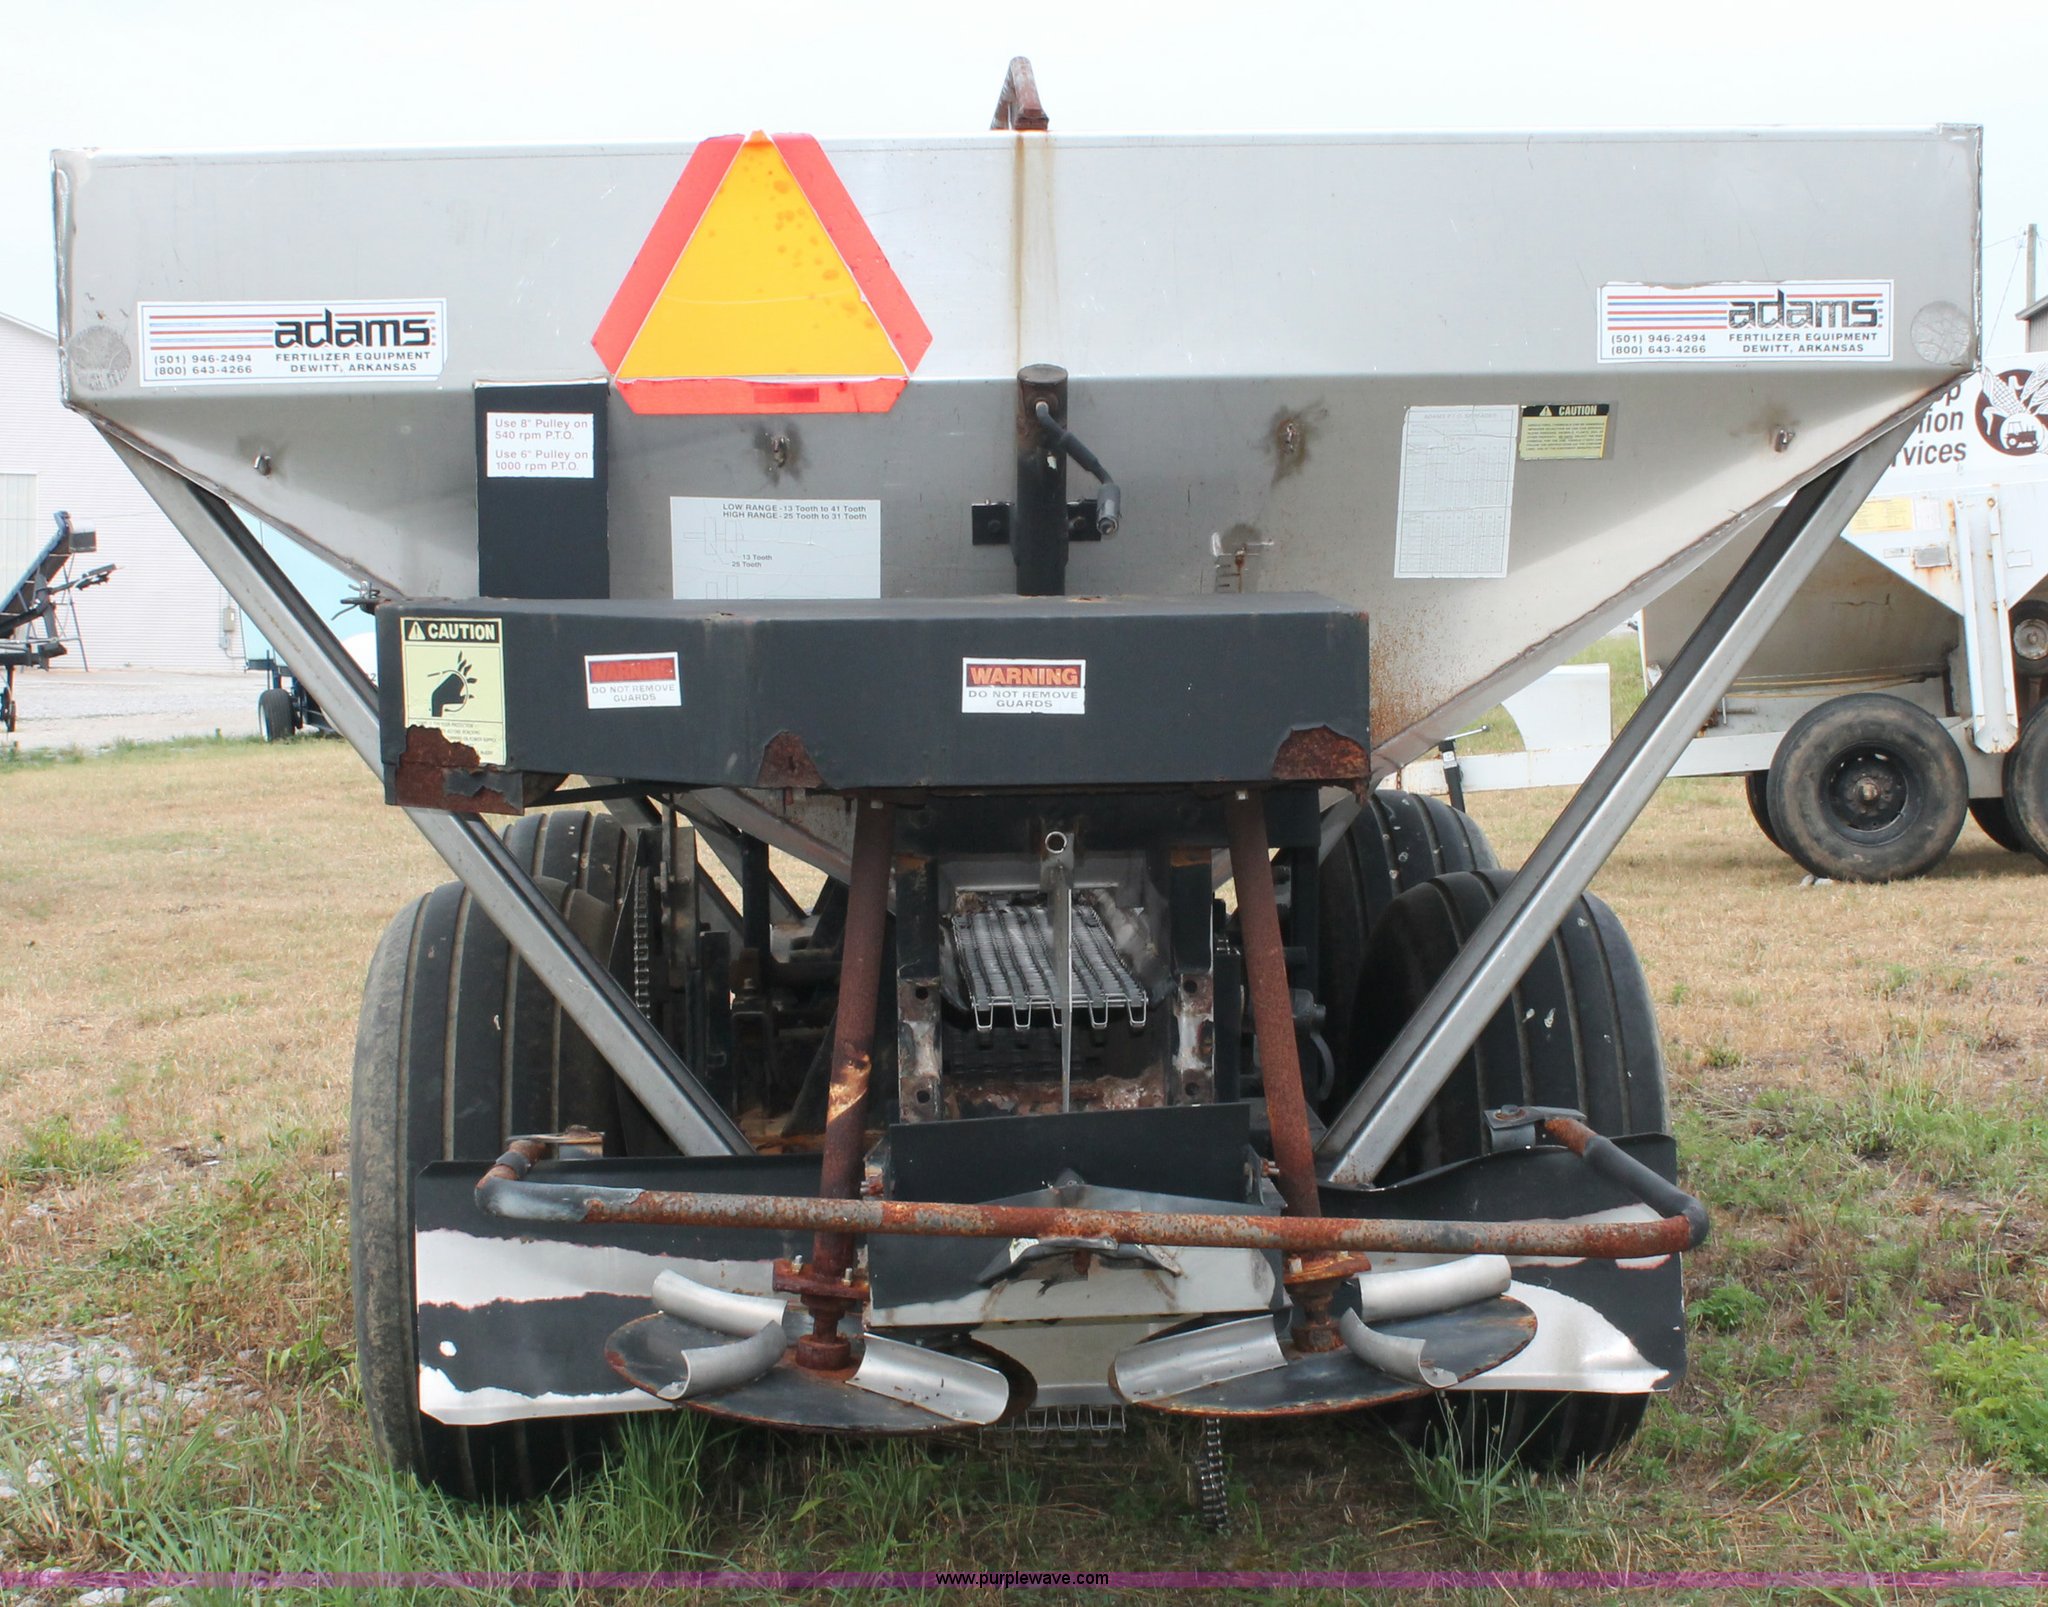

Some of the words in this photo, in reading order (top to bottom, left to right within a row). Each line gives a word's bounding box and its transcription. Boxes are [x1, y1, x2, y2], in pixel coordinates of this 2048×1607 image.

[1729, 289, 1877, 328] adams
[275, 307, 430, 348] adams
[1611, 334, 1643, 344] (501)
[1648, 334, 1706, 343] 946-2494
[1729, 333, 1800, 342] FERTILIZER
[1805, 332, 1877, 342] EQUIPMENT
[1611, 346, 1643, 355] (800)
[1648, 345, 1706, 354] 643-4266
[1798, 344, 1864, 352] ARKANSAS
[154, 355, 186, 365] (501)
[192, 354, 252, 363] 946-2494
[275, 353, 350, 362] FERTILIZER
[356, 351, 431, 360] EQUIPMENT
[154, 366, 186, 376] (800)
[192, 365, 252, 375] 643-4266
[349, 362, 417, 371] ARKANSAS
[1558, 405, 1597, 416] CAUTION
[495, 418, 517, 428] Use
[535, 419, 570, 430] Pulley
[495, 430, 515, 439] 540
[519, 432, 542, 441] rpm
[545, 431, 575, 440] P.T.O.
[495, 449, 517, 459] Use
[535, 450, 570, 461] Pulley
[496, 461, 521, 471] 1000
[524, 463, 547, 473] rpm
[722, 503, 743, 511] LOW
[747, 511, 778, 519] RANGE
[796, 512, 818, 520] Tooth
[427, 623, 495, 640] CAUTION
[970, 667, 1078, 685] WARNING
[632, 684, 675, 692] REMOVE
[613, 694, 656, 702] GUARDS
[969, 690, 987, 698] DO
